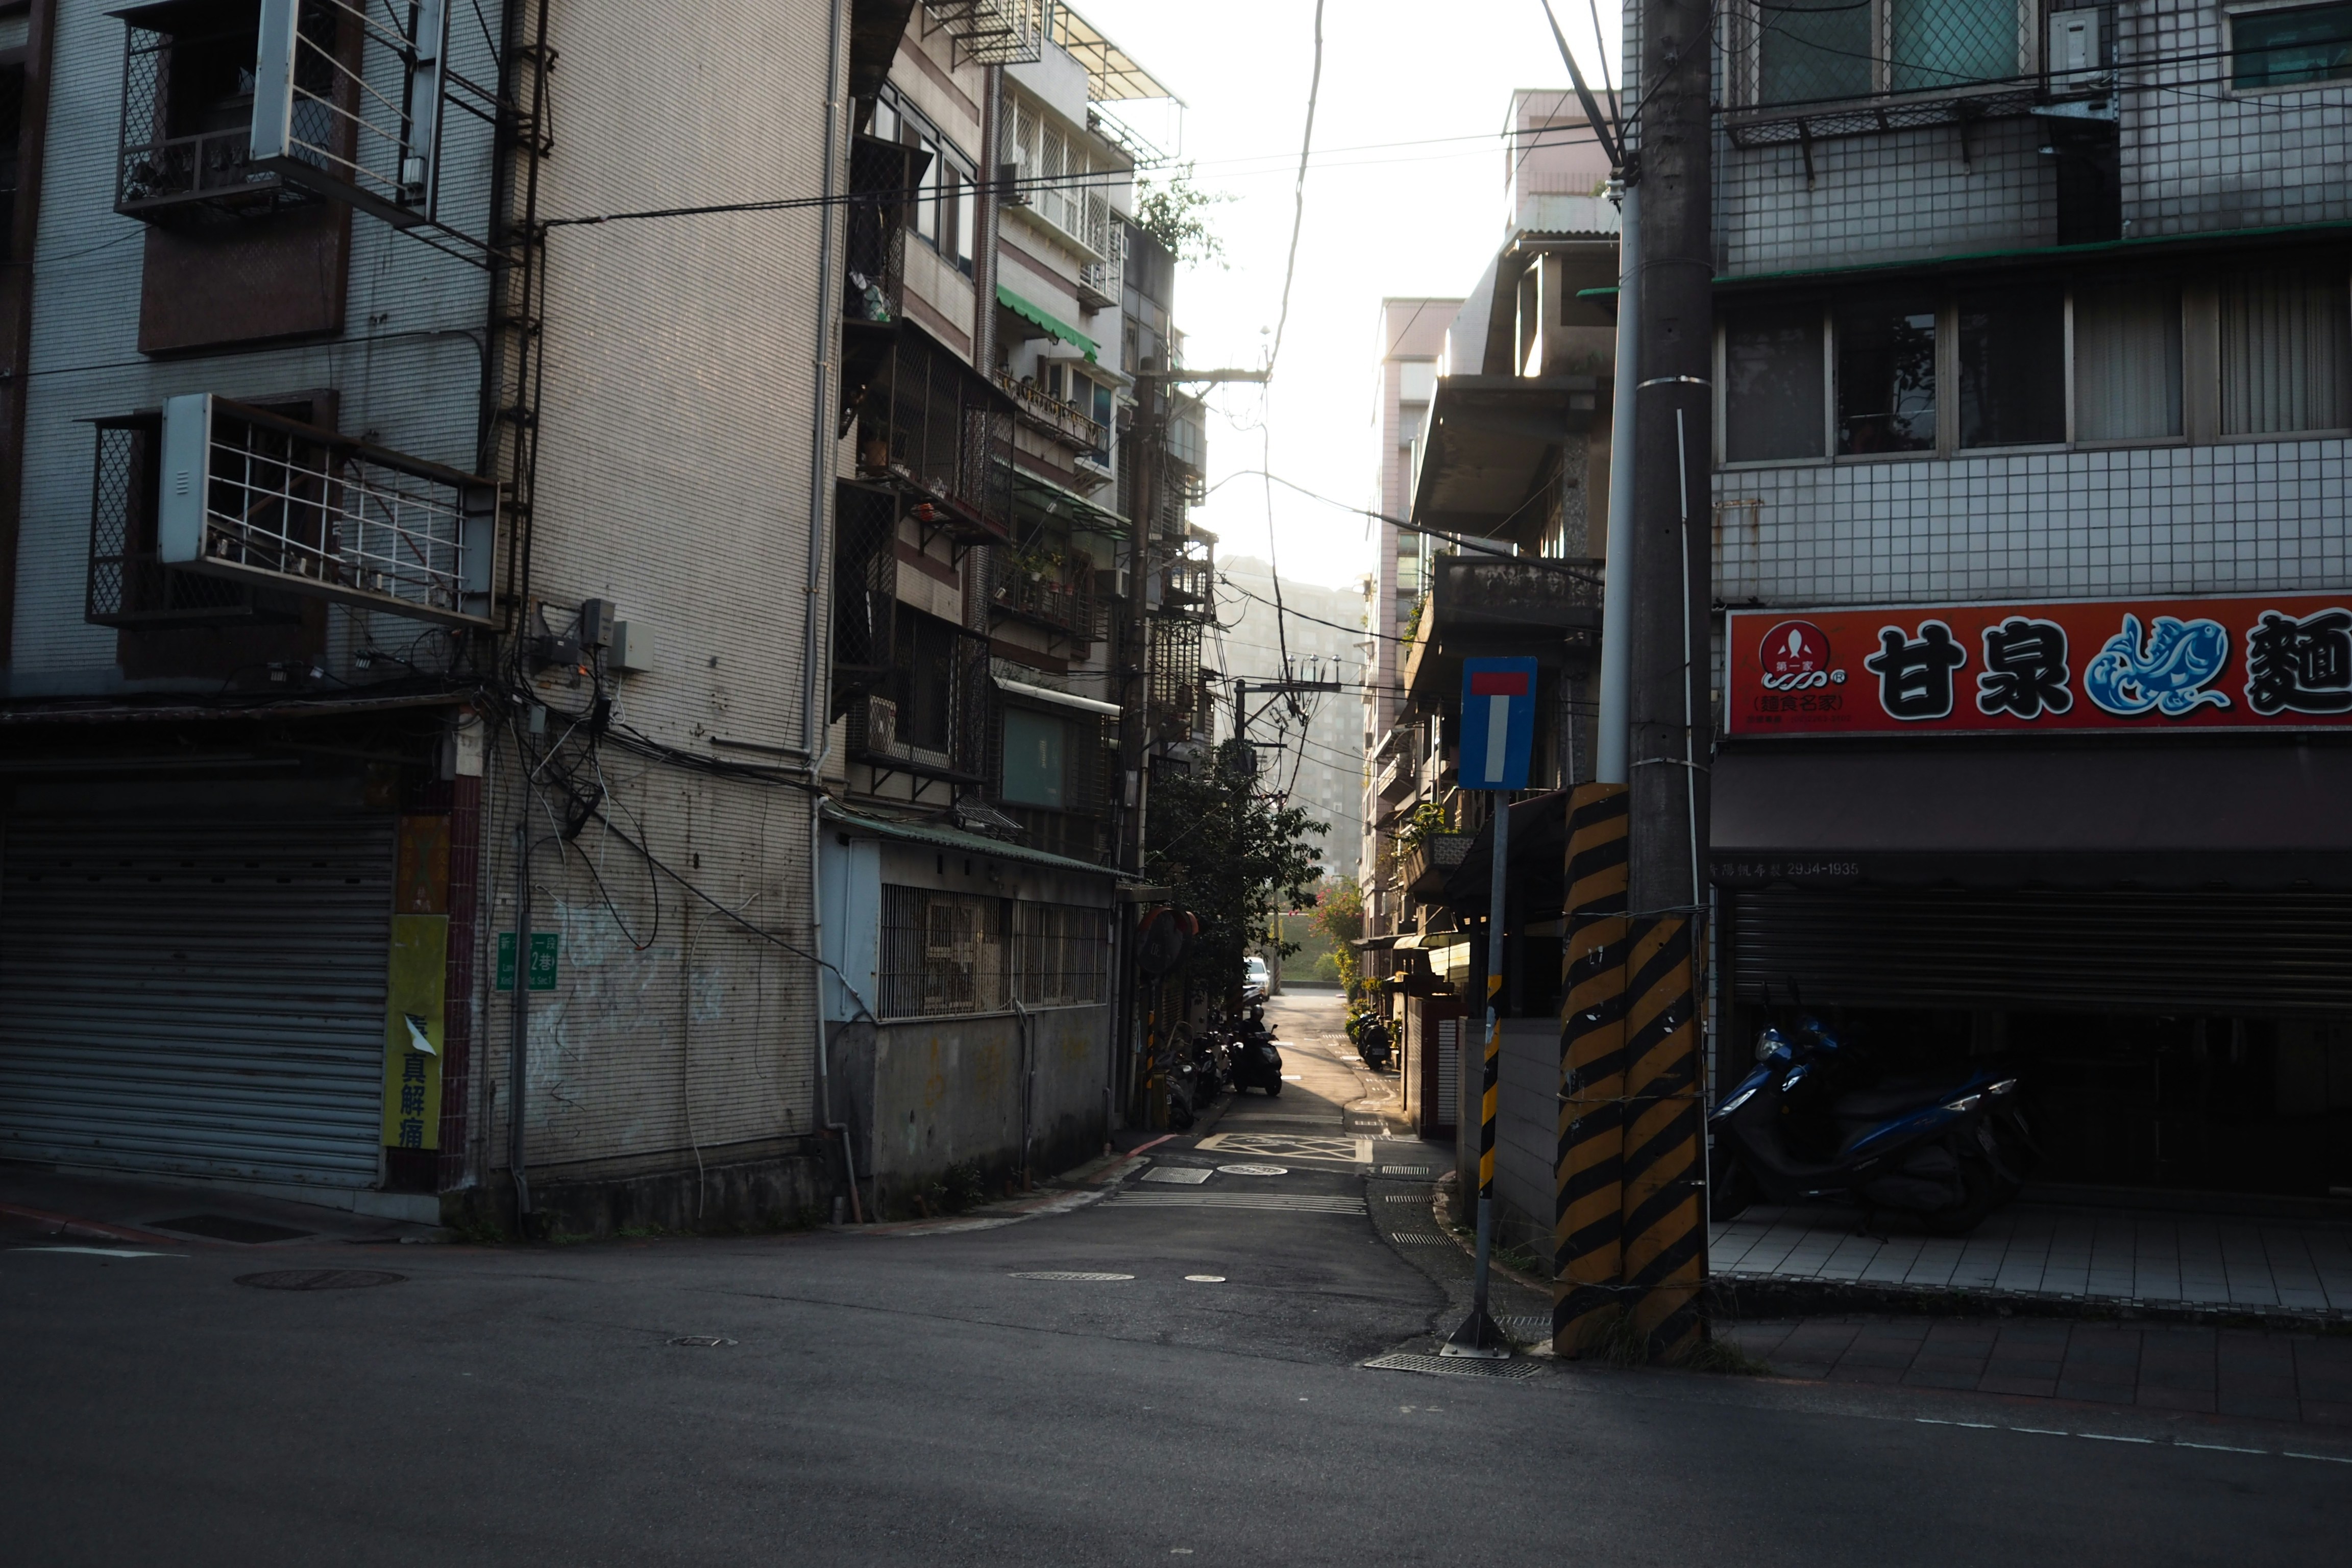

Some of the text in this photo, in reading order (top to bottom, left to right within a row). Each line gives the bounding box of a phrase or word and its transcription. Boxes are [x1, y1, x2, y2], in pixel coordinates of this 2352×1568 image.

[1776, 661, 1813, 671] 第一家
[1864, 607, 2352, 721] 甘泉 麵
[501, 937, 555, 949] 新一段
